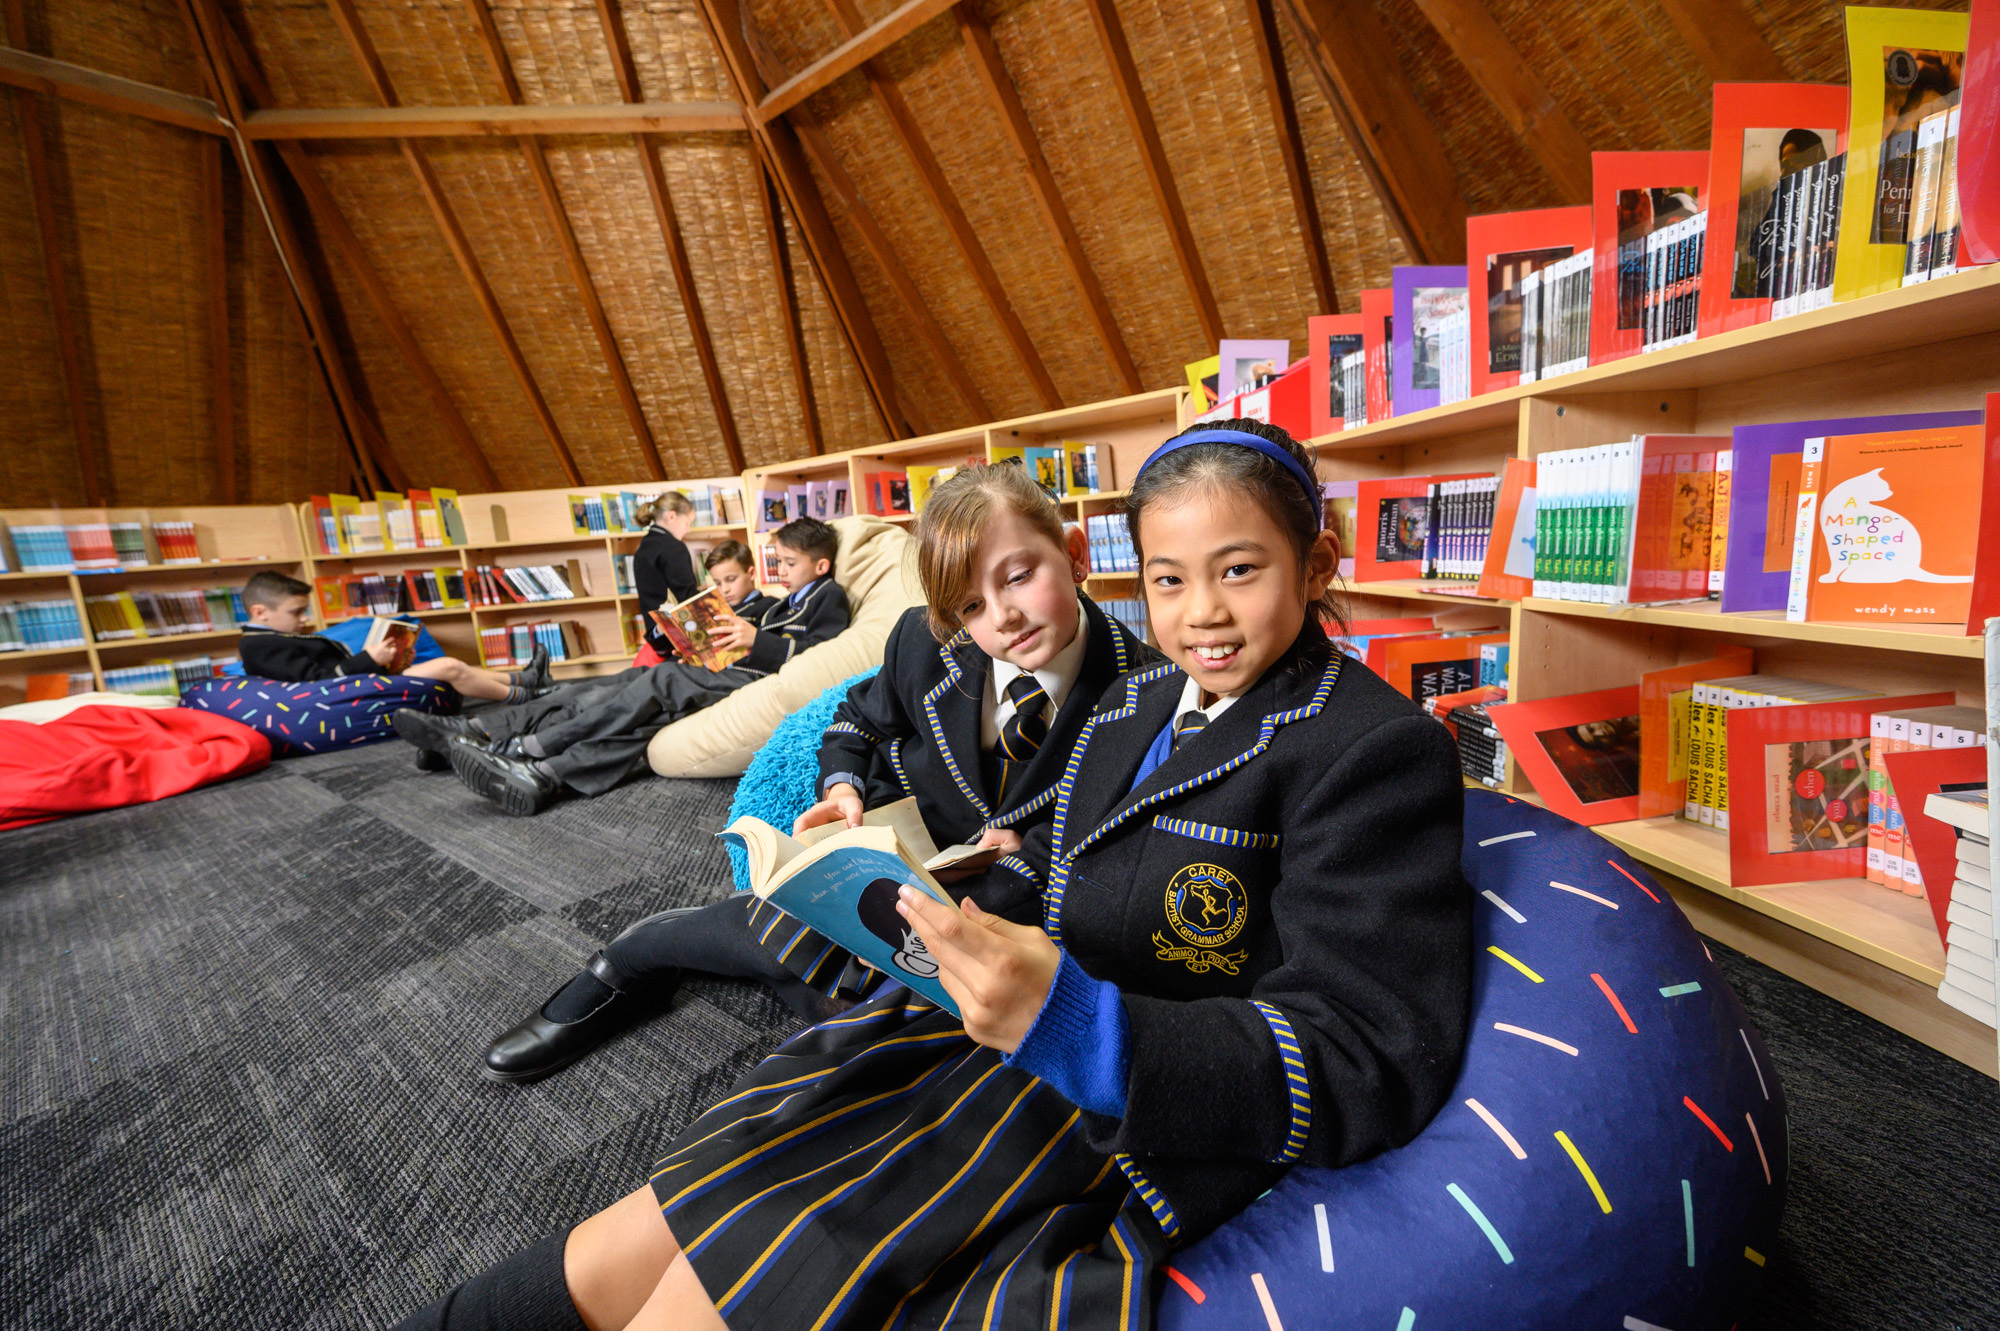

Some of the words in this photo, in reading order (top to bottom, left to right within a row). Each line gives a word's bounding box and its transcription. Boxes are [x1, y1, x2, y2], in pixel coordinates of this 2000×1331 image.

[1718, 473, 1728, 496] AJ
[1844, 497, 1858, 508] A
[1380, 512, 1388, 547] morris
[1386, 504, 1398, 555] gleitzman
[1825, 514, 1900, 533] Mango-
[1855, 604, 1897, 616] wendy
[1441, 667, 1455, 696] WAL
[1458, 672, 1471, 681] A
[1458, 685, 1471, 693] L
[1690, 739, 1700, 765] LOUIS
[1704, 743, 1715, 769] LOUIS
[1688, 769, 1699, 802] SACHA
[1703, 772, 1713, 807] SACHA
[1807, 770, 1815, 797] when
[1874, 772, 1884, 791] when
[1718, 776, 1728, 810] SACHA
[1872, 792, 1880, 803] you
[1833, 802, 1842, 819] you
[1874, 805, 1883, 824] reach
[1891, 810, 1899, 828] reach
[824, 870, 840, 880] You
[1188, 866, 1233, 883] CAREY
[811, 890, 828, 903] when
[831, 881, 843, 892] you
[845, 872, 860, 881] were
[1168, 891, 1183, 927] BAPTIST
[1180, 926, 1225, 945] GRAMMAR
[1224, 905, 1245, 938] SCHOOL
[1168, 950, 1193, 958] ANIMO
[1208, 954, 1227, 967] FIDE
